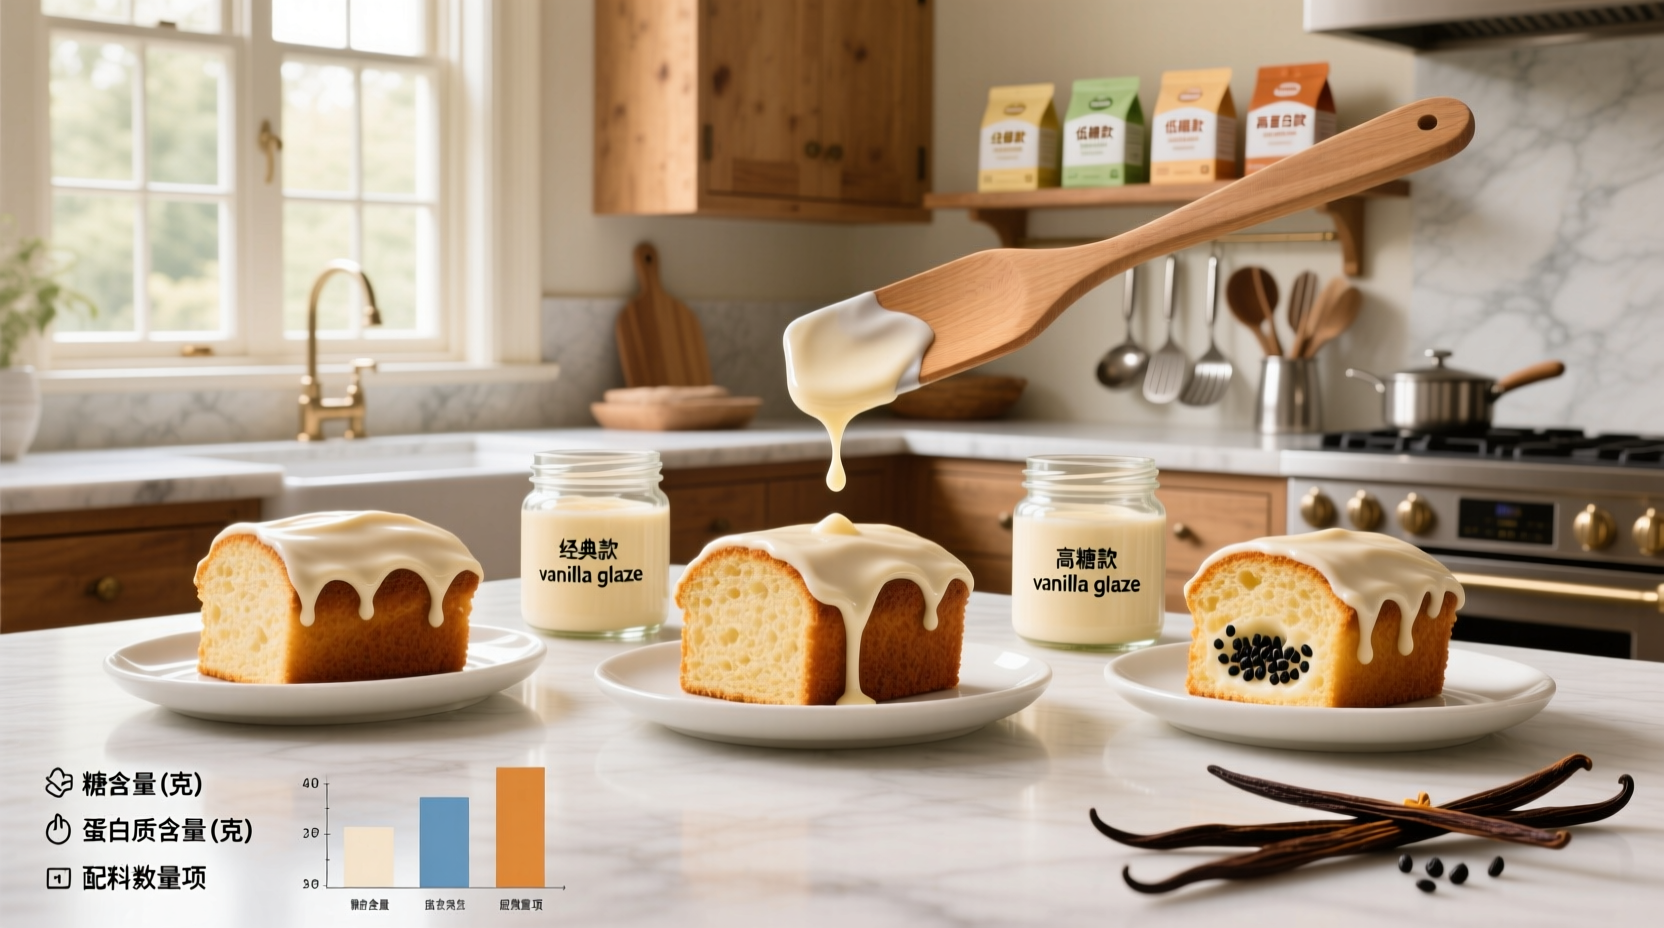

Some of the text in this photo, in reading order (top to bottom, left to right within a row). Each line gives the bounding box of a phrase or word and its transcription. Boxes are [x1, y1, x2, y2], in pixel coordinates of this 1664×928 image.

[558, 537, 619, 561] 经典款
[1056, 546, 1118, 570] 高糖款
[538, 565, 644, 588] vanilla glaze
[1033, 574, 1141, 598] vanilla glaze
